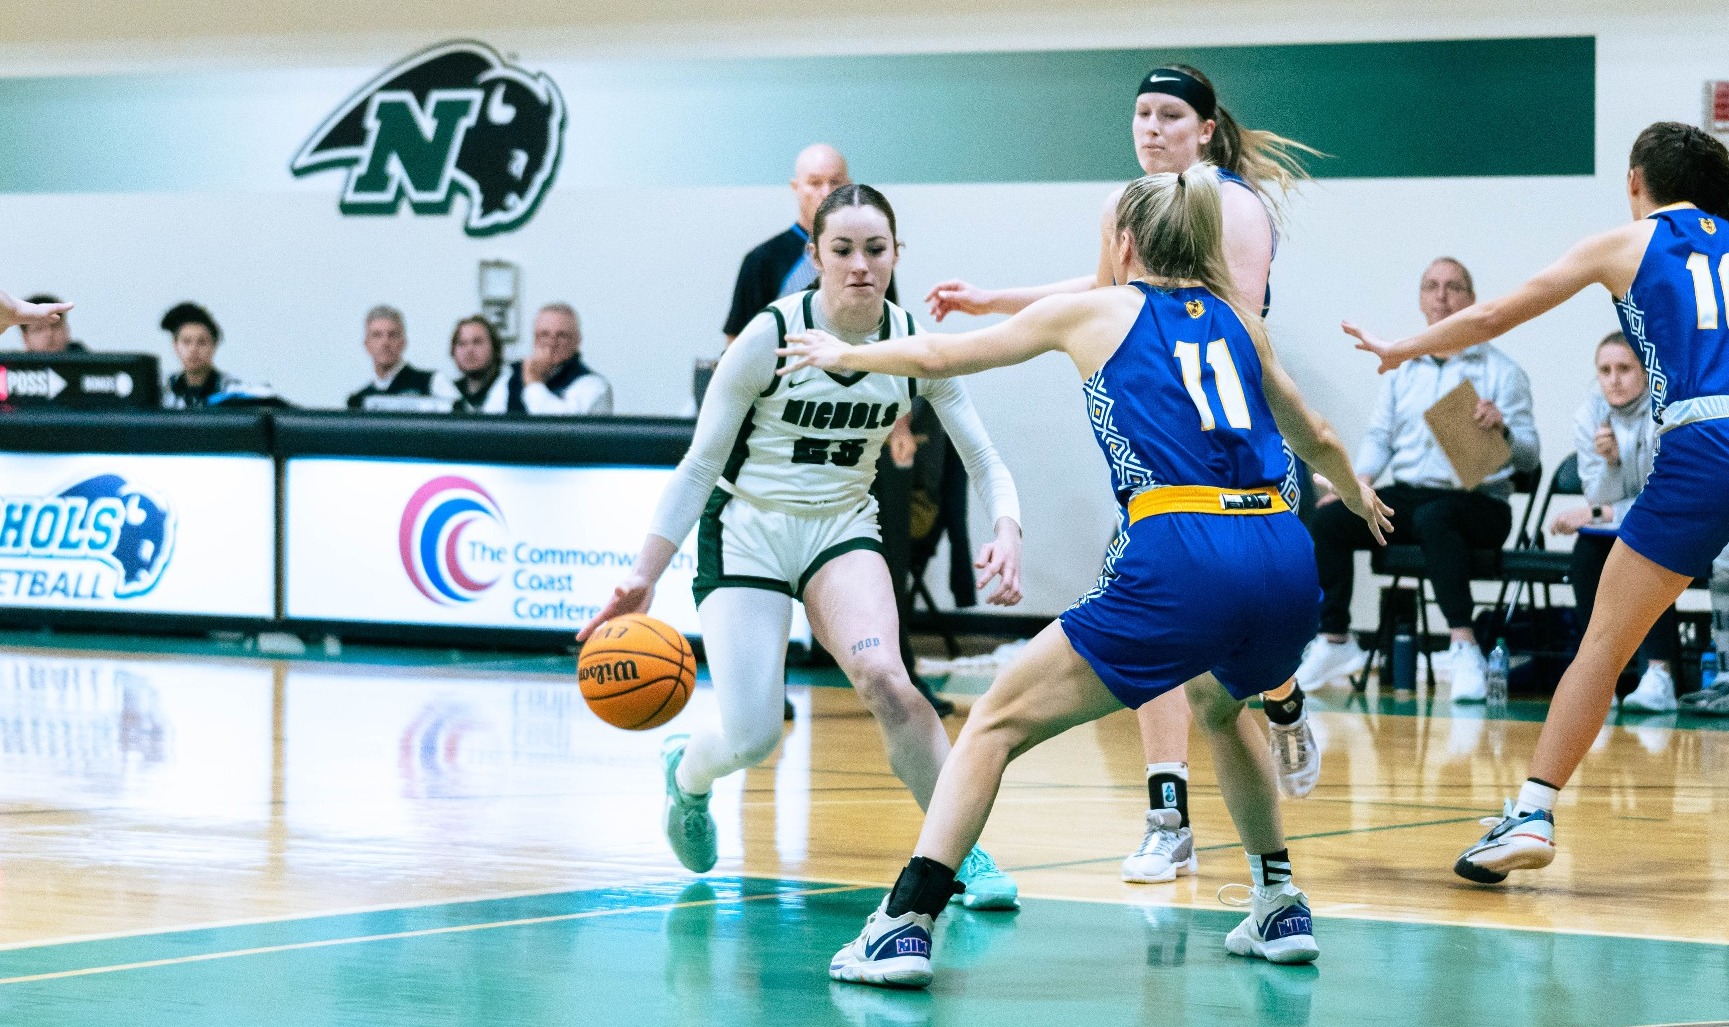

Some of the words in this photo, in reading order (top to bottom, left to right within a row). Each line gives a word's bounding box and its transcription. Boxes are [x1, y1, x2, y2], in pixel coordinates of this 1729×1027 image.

[346, 92, 483, 203] N
[7, 370, 48, 396] POSS
[1174, 338, 1251, 431] 11
[781, 399, 899, 430] NICHOLS
[469, 541, 507, 563] The
[513, 542, 693, 569] Commonwth
[513, 568, 574, 592] Coast
[513, 597, 602, 620] Confere
[578, 660, 640, 685] Wilson
[896, 937, 929, 955] NIK
